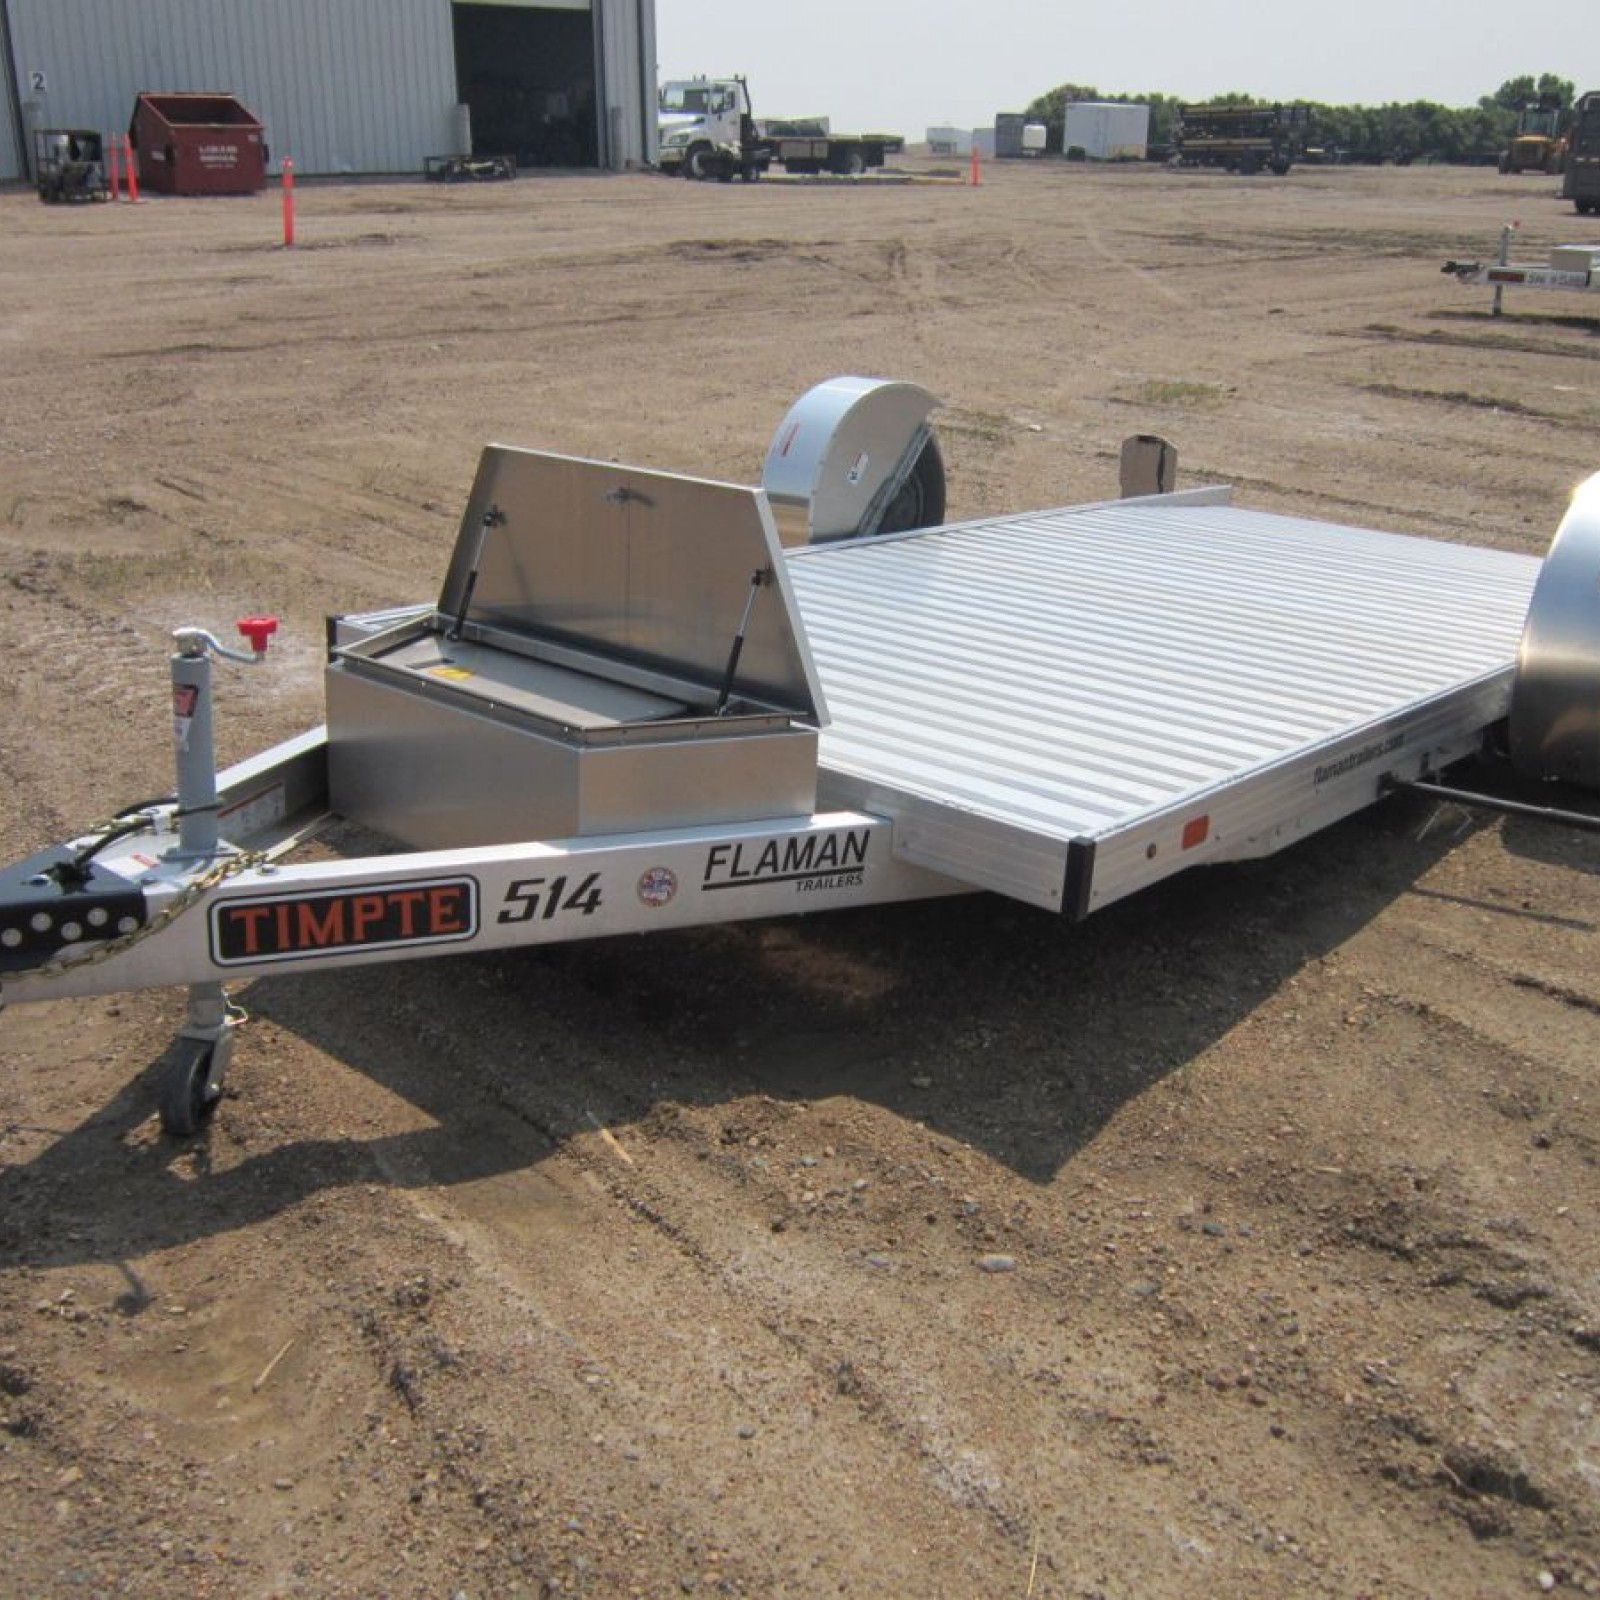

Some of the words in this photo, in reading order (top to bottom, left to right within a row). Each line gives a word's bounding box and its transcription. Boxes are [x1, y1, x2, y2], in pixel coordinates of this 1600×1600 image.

[32, 72, 45, 90] 2
[704, 829, 870, 881] FLAMAN
[795, 874, 864, 892] TRAILERS
[230, 887, 462, 954] TIMPTE
[497, 872, 602, 924] 514
